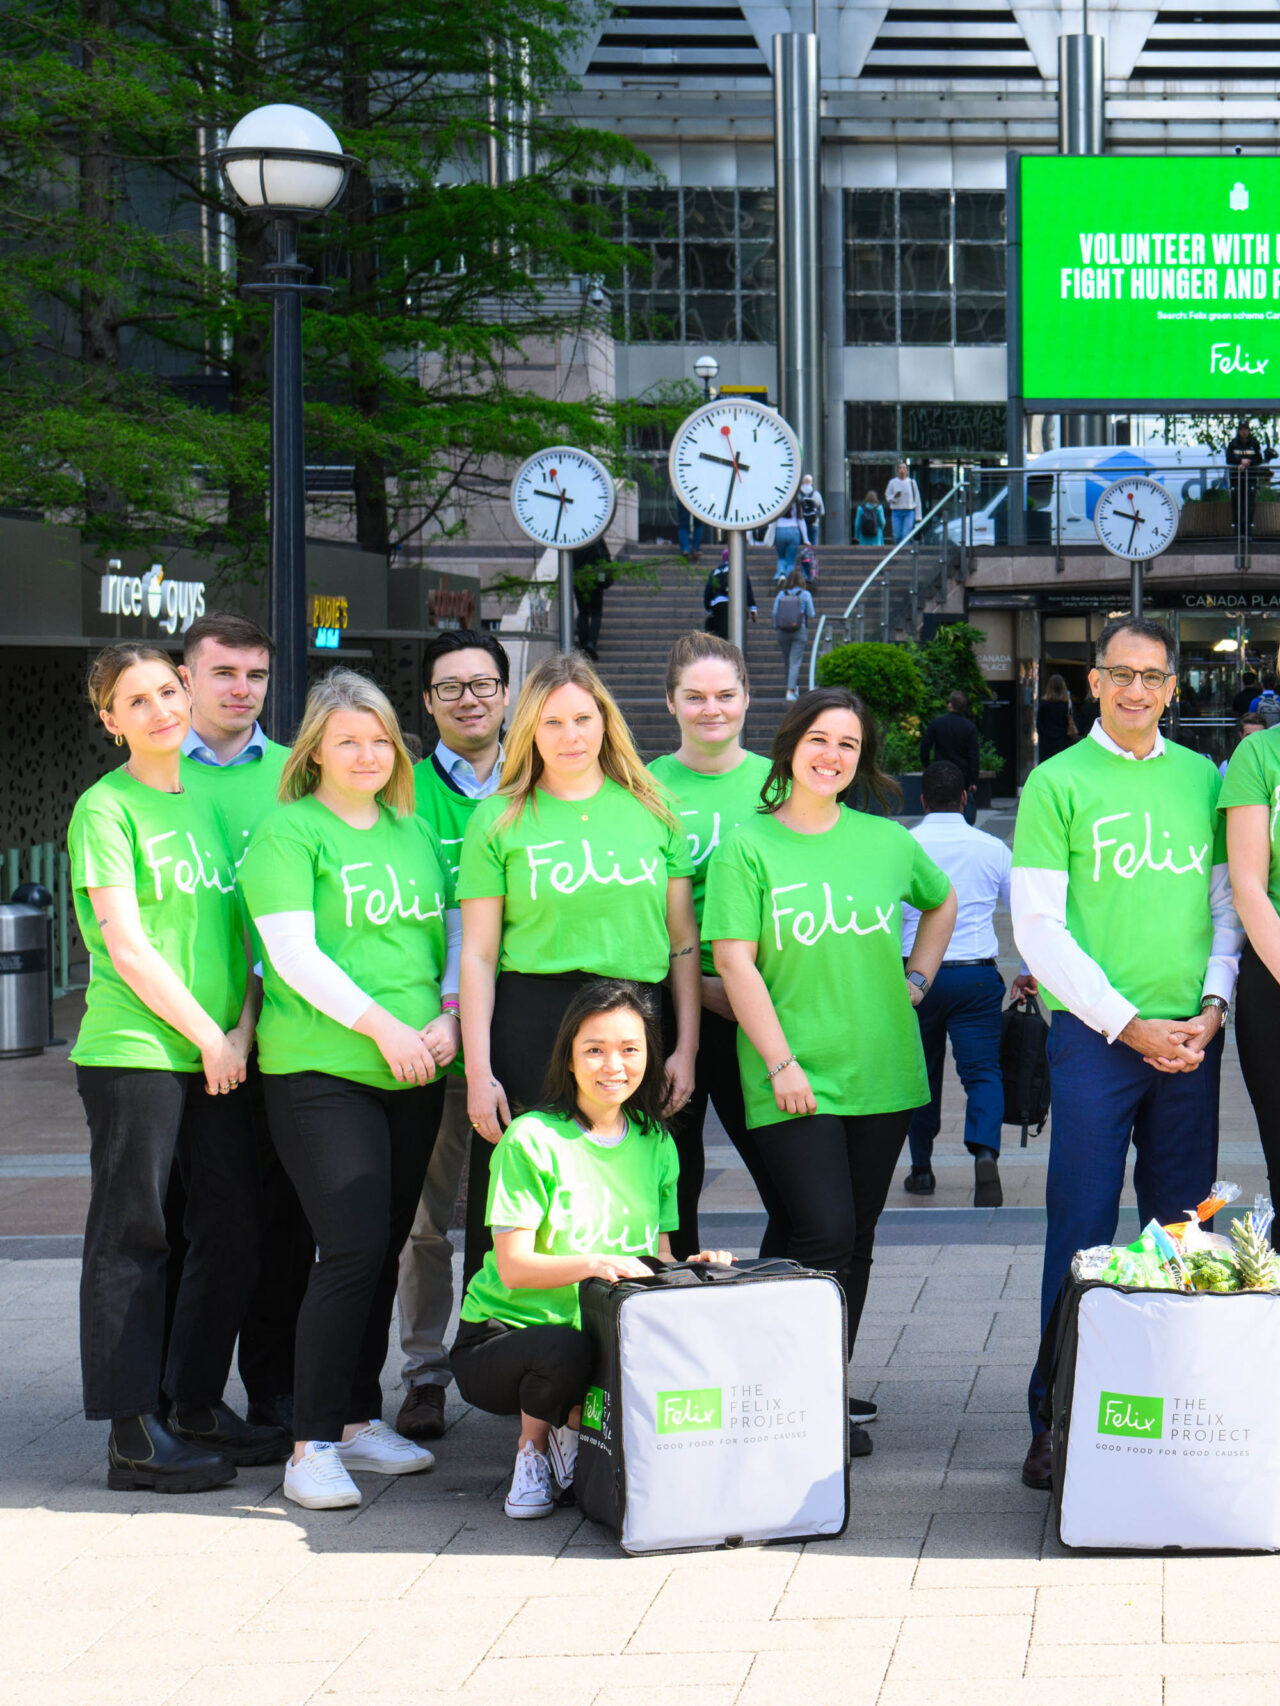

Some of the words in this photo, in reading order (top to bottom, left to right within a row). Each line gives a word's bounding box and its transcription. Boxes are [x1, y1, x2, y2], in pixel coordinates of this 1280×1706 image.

[1079, 233, 1205, 265] VOLUNTEER
[1211, 233, 1270, 265] WITH
[1061, 268, 1125, 300] FIGHT
[1130, 268, 1218, 300] HUNGER
[1223, 268, 1267, 300] AND
[1157, 311, 1187, 320] Search:
[1188, 311, 1207, 320] Felix
[1209, 312, 1232, 322] green
[1233, 311, 1264, 320] scheme
[1210, 343, 1268, 374] Felix
[102, 559, 142, 616] rice
[162, 579, 206, 635] guys
[1185, 594, 1247, 607] CANADA
[976, 655, 1012, 663] CANADA
[1091, 811, 1209, 883] Felix
[526, 839, 658, 901] Felix
[340, 861, 445, 928] Felix
[771, 882, 895, 951] Felix
[730, 1383, 763, 1398] THE
[663, 1397, 716, 1427] Felix
[730, 1398, 782, 1413] FELIX
[1173, 1397, 1208, 1411] THE
[730, 1410, 807, 1429] PROJECT
[1104, 1399, 1156, 1432] Felix
[1171, 1413, 1224, 1426] FELIX
[656, 1442, 684, 1451] GOOD
[689, 1439, 714, 1448] FOOD
[719, 1437, 738, 1446] FOR
[743, 1435, 769, 1444] GOOD
[774, 1430, 808, 1441] CAUSES
[1170, 1428, 1251, 1444] PROJECT
[1095, 1442, 1122, 1452] GOOD
[1127, 1446, 1153, 1455] FOOD
[1159, 1448, 1177, 1456] FOR
[1182, 1449, 1210, 1457] GOOD
[1215, 1449, 1250, 1457] CAUSES
